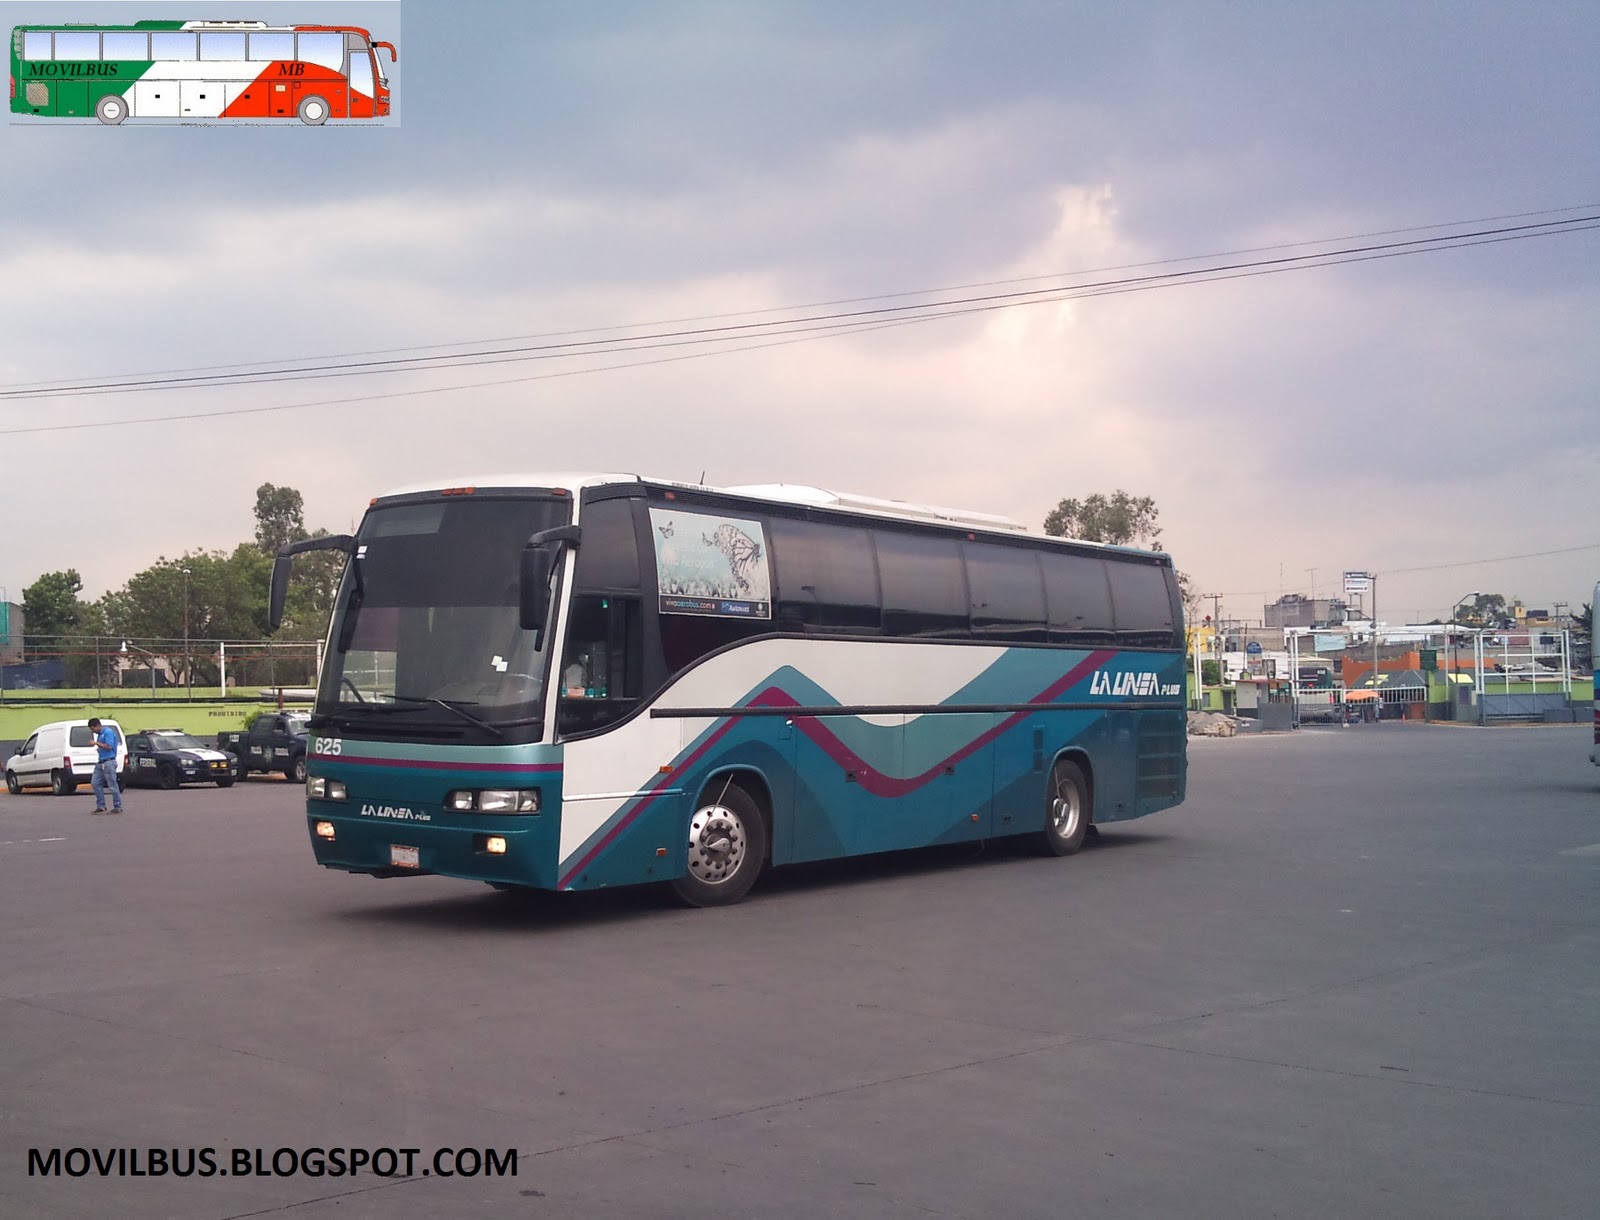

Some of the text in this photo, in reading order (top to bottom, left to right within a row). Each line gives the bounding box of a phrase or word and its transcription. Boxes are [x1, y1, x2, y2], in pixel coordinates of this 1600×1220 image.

[1089, 670, 1181, 696] LA LINEA PLUS
[315, 738, 342, 756] 625
[361, 804, 432, 821] LA LINEA PLUS
